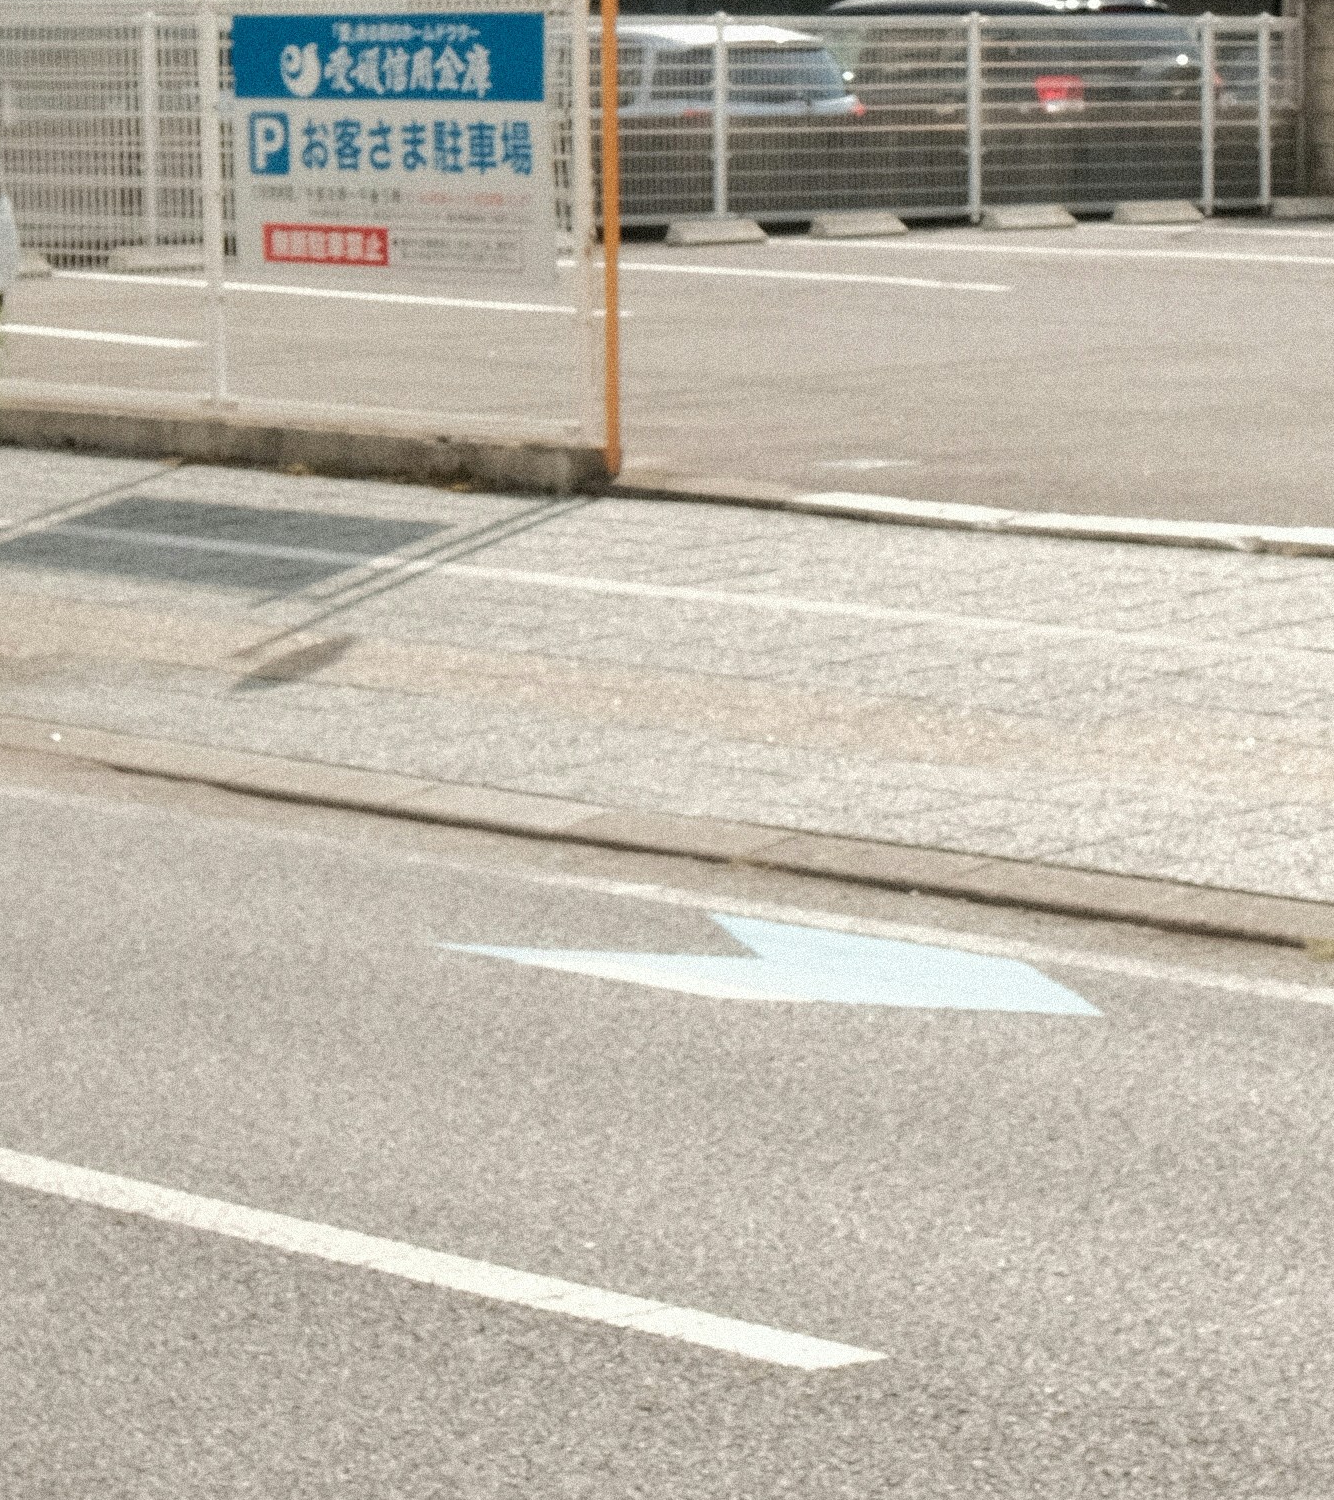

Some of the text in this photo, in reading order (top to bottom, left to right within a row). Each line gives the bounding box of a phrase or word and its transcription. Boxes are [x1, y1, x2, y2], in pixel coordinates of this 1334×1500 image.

[323, 42, 493, 98] 愛媛信用金庫
[252, 115, 534, 177] P お客さま駐車場
